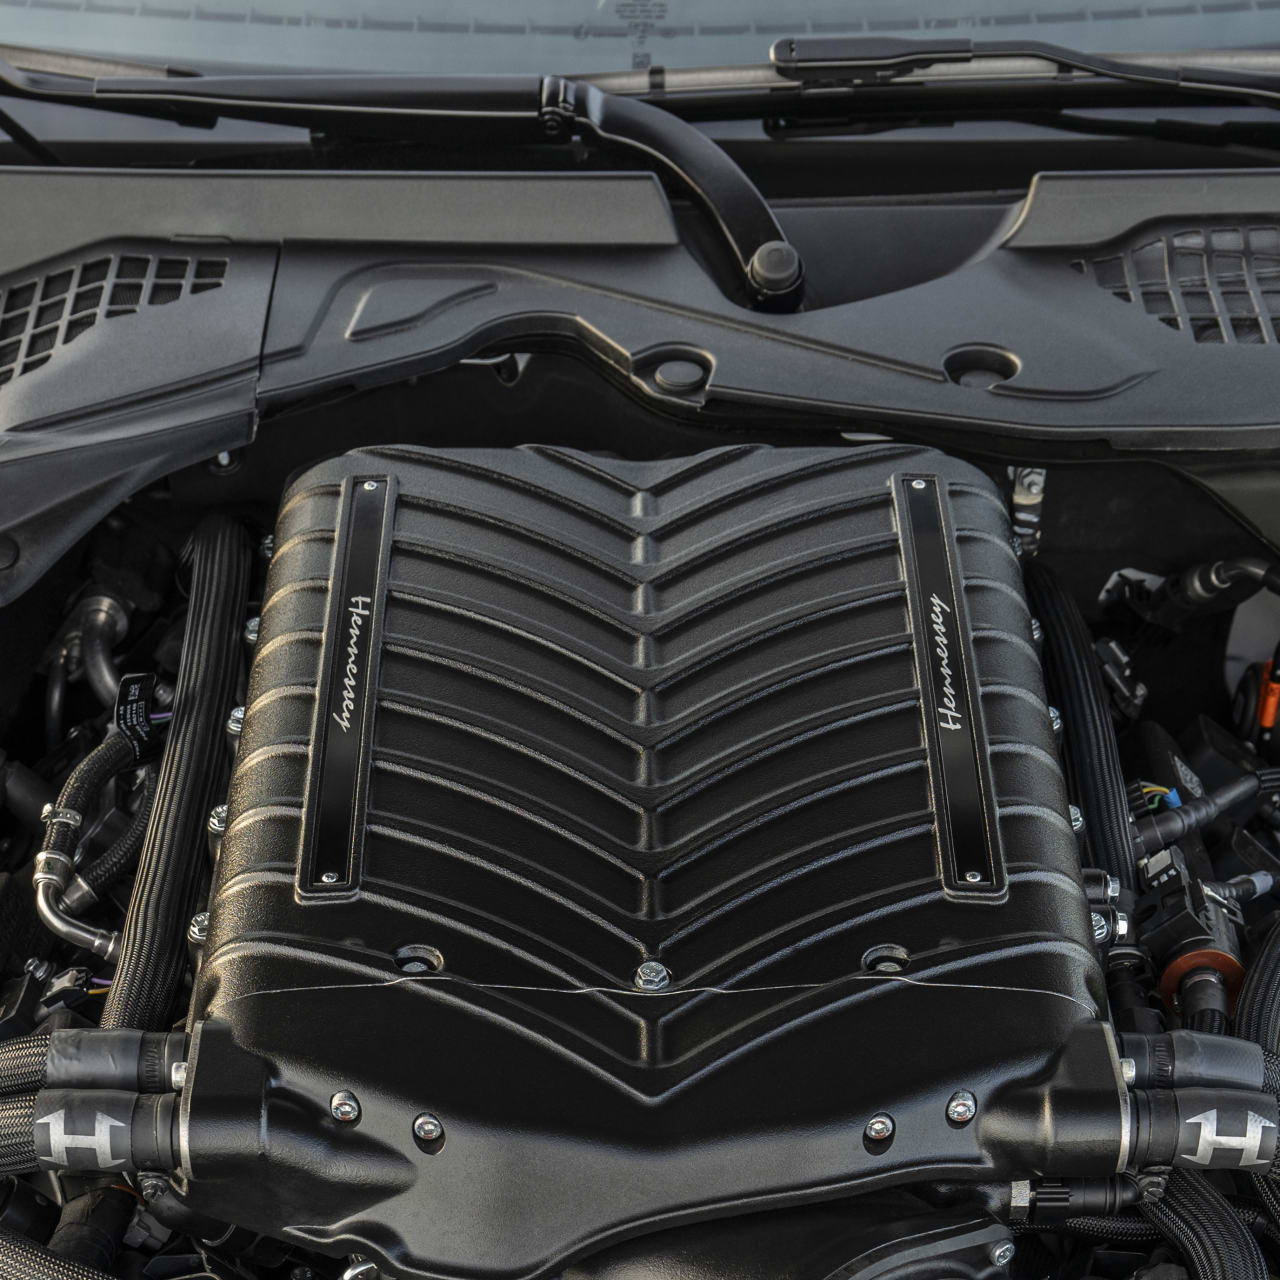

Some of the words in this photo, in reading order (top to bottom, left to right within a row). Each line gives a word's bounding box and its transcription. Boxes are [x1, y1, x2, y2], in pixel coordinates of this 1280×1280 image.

[333, 596, 371, 733] Hennessey
[930, 593, 962, 730] Hennessey
[35, 1108, 127, 1168] H
[1180, 1108, 1277, 1167] H
